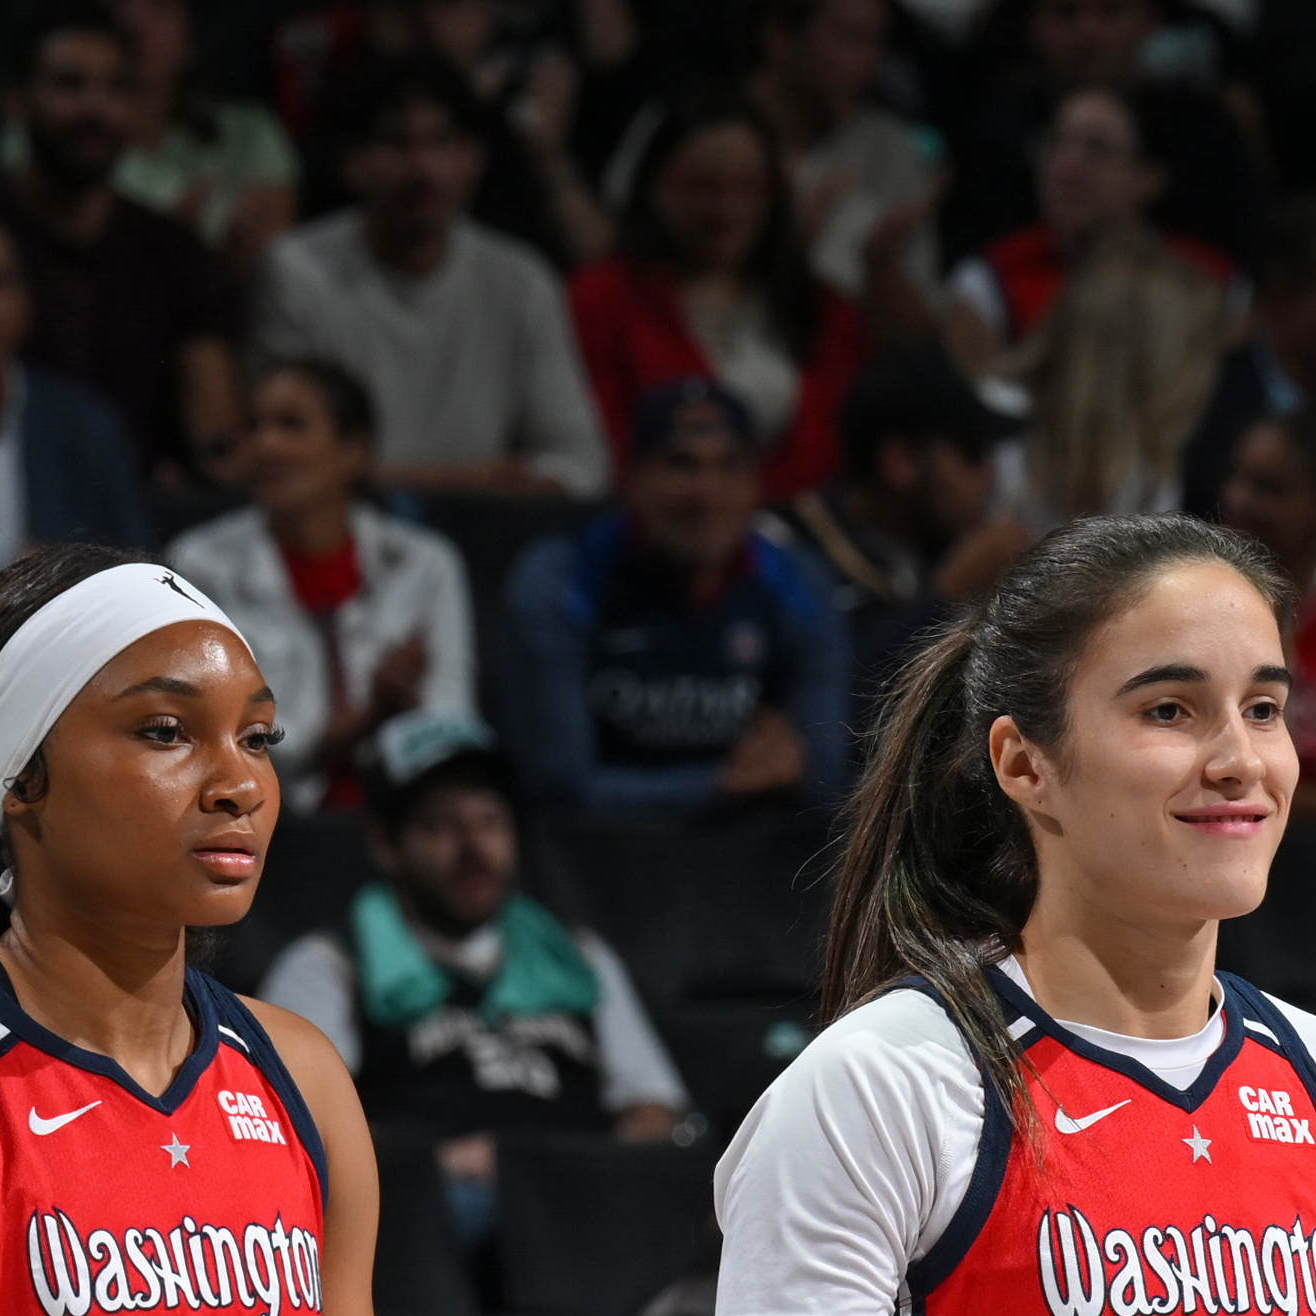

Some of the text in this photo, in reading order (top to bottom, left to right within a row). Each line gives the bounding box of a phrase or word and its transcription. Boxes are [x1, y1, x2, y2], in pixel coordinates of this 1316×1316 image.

[218, 1090, 267, 1118] CAR
[1238, 1086, 1294, 1116] CAR
[227, 1115, 286, 1145] max
[1246, 1113, 1315, 1145] max
